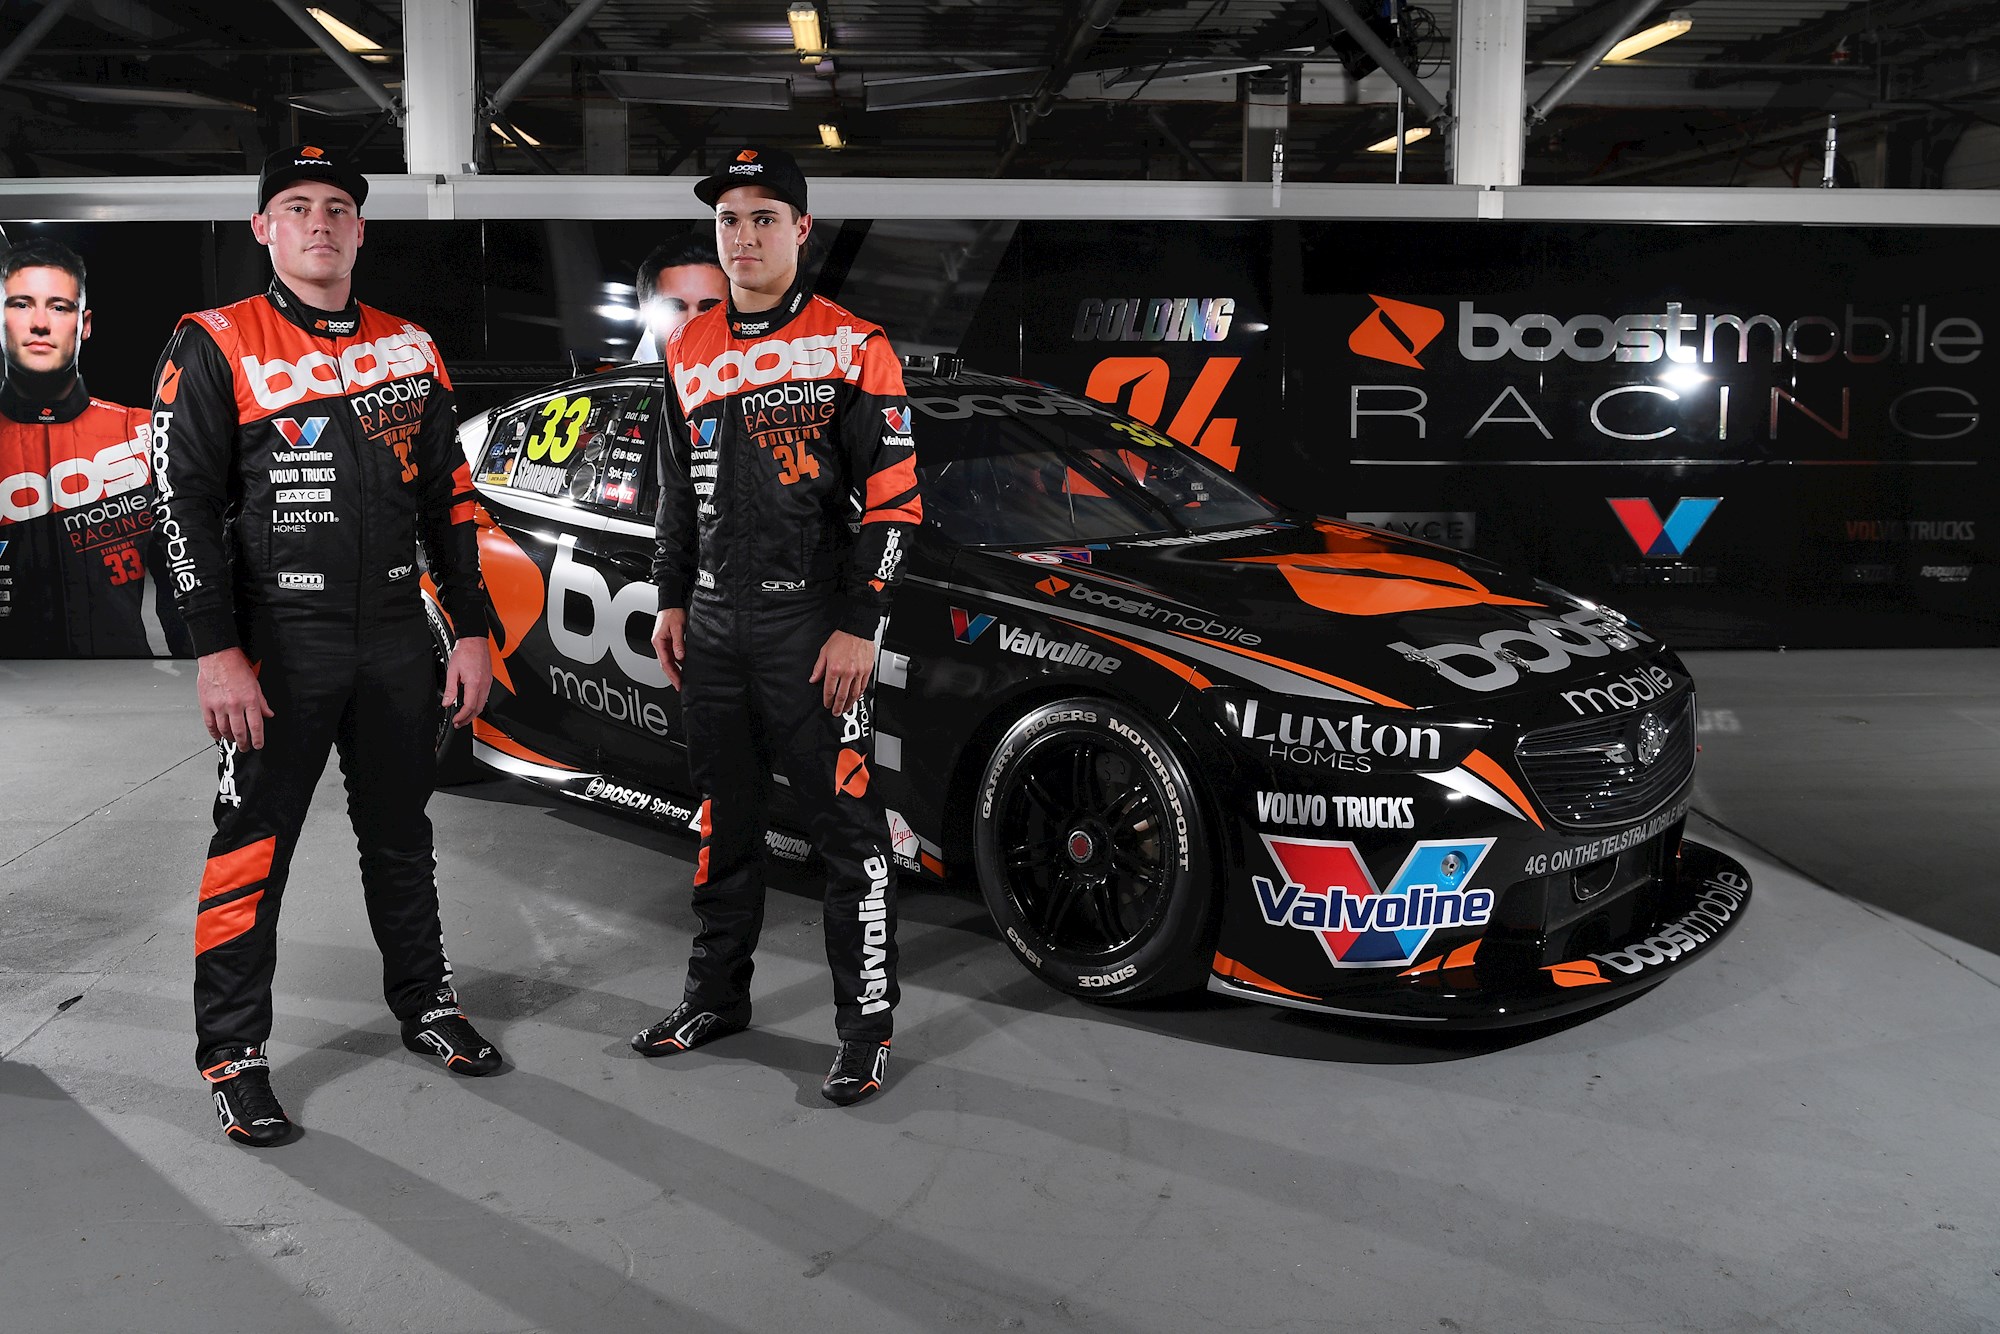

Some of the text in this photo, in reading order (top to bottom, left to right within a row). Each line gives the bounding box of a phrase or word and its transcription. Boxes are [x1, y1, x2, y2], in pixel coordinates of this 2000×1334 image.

[728, 162, 764, 175] boost
[741, 320, 770, 331] boost
[1072, 297, 1236, 342] GOLDING
[1457, 299, 1983, 365] boostmobile
[838, 328, 850, 365] mobile
[241, 325, 440, 411] boost
[674, 326, 868, 413] boost
[350, 377, 431, 417] mobile
[358, 397, 429, 435] RACIN
[741, 382, 836, 416] mobile
[1349, 384, 1981, 441] RACING
[526, 395, 591, 464] 33
[269, 467, 338, 484] VOLVO TRUCKS
[271, 450, 334, 463] Valvoline
[512, 456, 569, 495] Stanaway
[772, 441, 821, 486] 34
[63, 494, 148, 532] mobile
[278, 491, 327, 501] PAYCE
[69, 511, 155, 548] RACING
[272, 524, 307, 534] HOMES
[1908, 520, 1976, 540] TRUCKS
[102, 547, 146, 586] 33
[873, 527, 902, 580] boost
[281, 572, 323, 584] rpm
[1069, 582, 1263, 647] boostmobile
[998, 623, 1124, 676] Valvoline
[1387, 601, 1656, 692] boost
[550, 664, 669, 737] mobile
[1560, 665, 1673, 716] mobile
[1242, 699, 1442, 762] Luxton
[1268, 744, 1373, 775] HOMES
[601, 783, 692, 821] BOSCH Spicers
[982, 709, 1190, 872] GARRY ROGERS MOTORSPORT
[1256, 791, 1416, 831] VOLVO TRUCKS
[892, 852, 922, 873] stralia
[1524, 854, 1548, 876] 4G
[1550, 848, 1574, 872] ON
[1575, 841, 1601, 866] THE
[1600, 824, 1648, 857] TELSTRA
[1252, 874, 1495, 935] Valvoline
[1587, 868, 1750, 977] boostmobile
[1005, 926, 1138, 988] SINCE 1963
